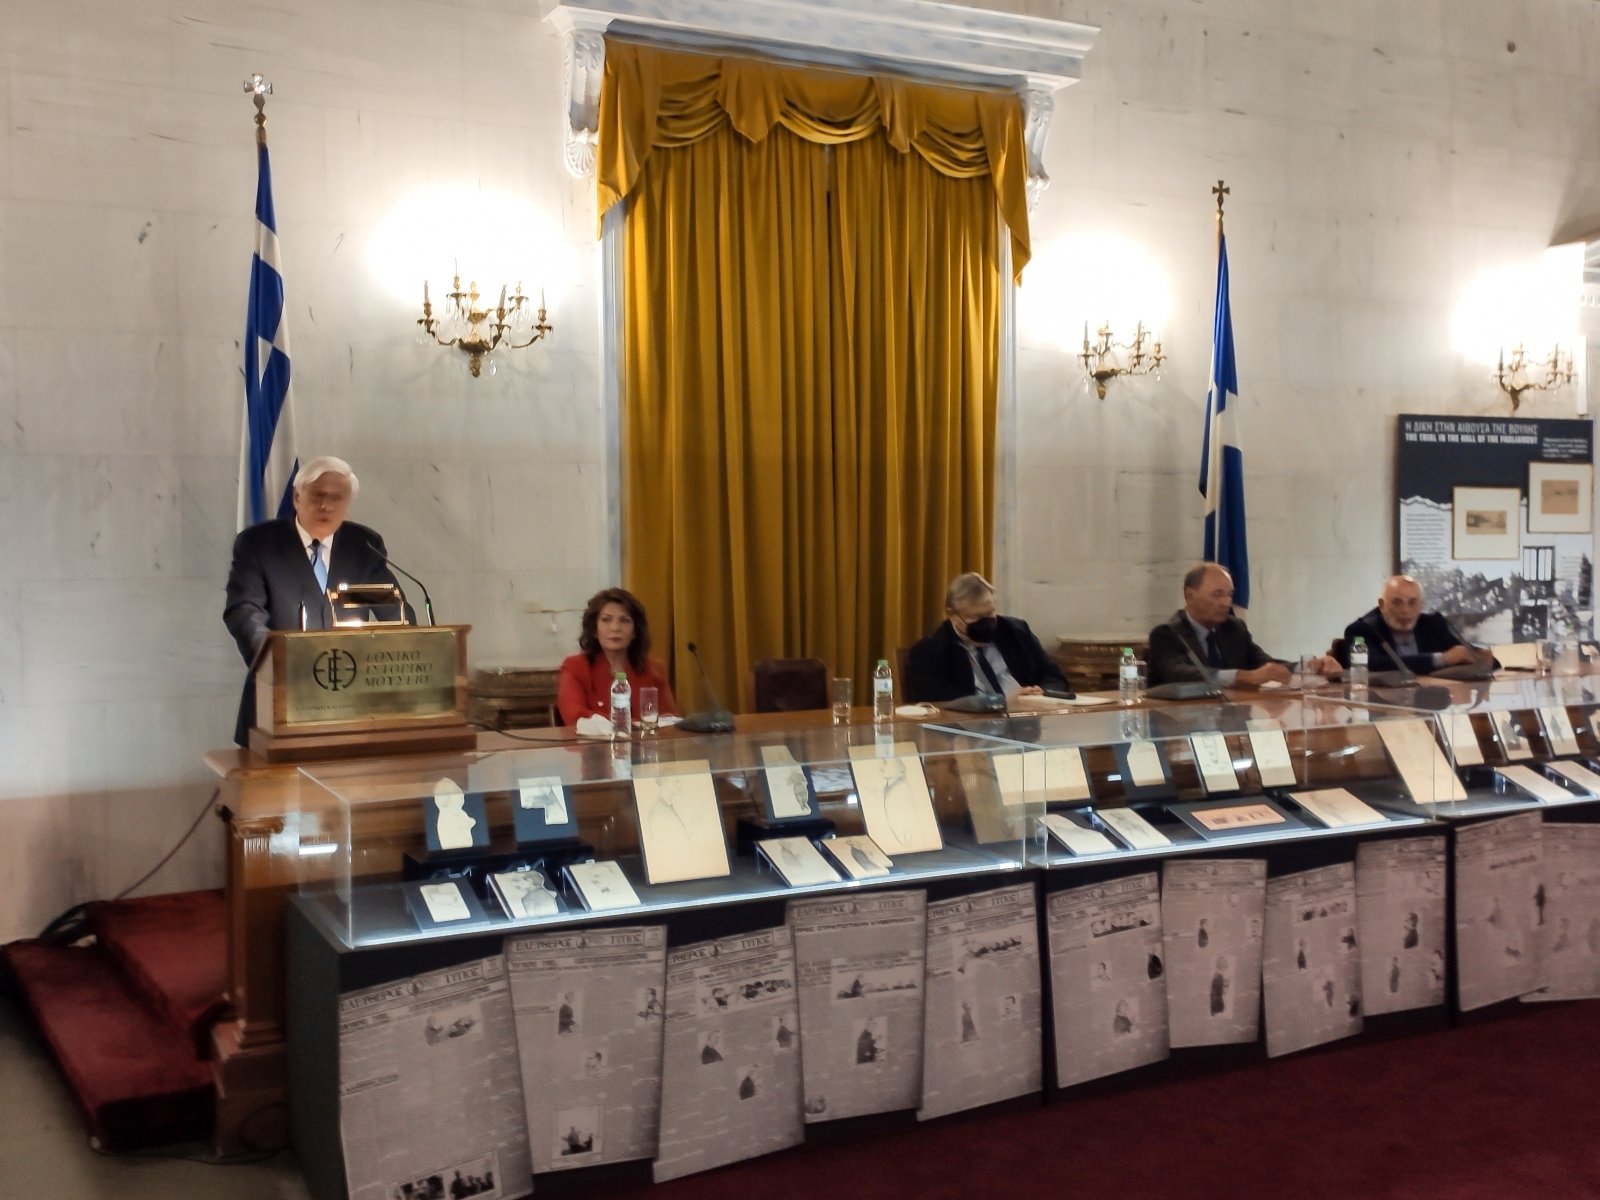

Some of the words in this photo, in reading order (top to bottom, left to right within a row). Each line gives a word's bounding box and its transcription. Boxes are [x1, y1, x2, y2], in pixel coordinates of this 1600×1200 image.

[1413, 421, 1433, 433] ΔΙΚΗ
[1434, 421, 1456, 433] ΣΤΗΝ
[1492, 423, 1507, 434] ΤΗΣ
[1405, 433, 1418, 442] THE
